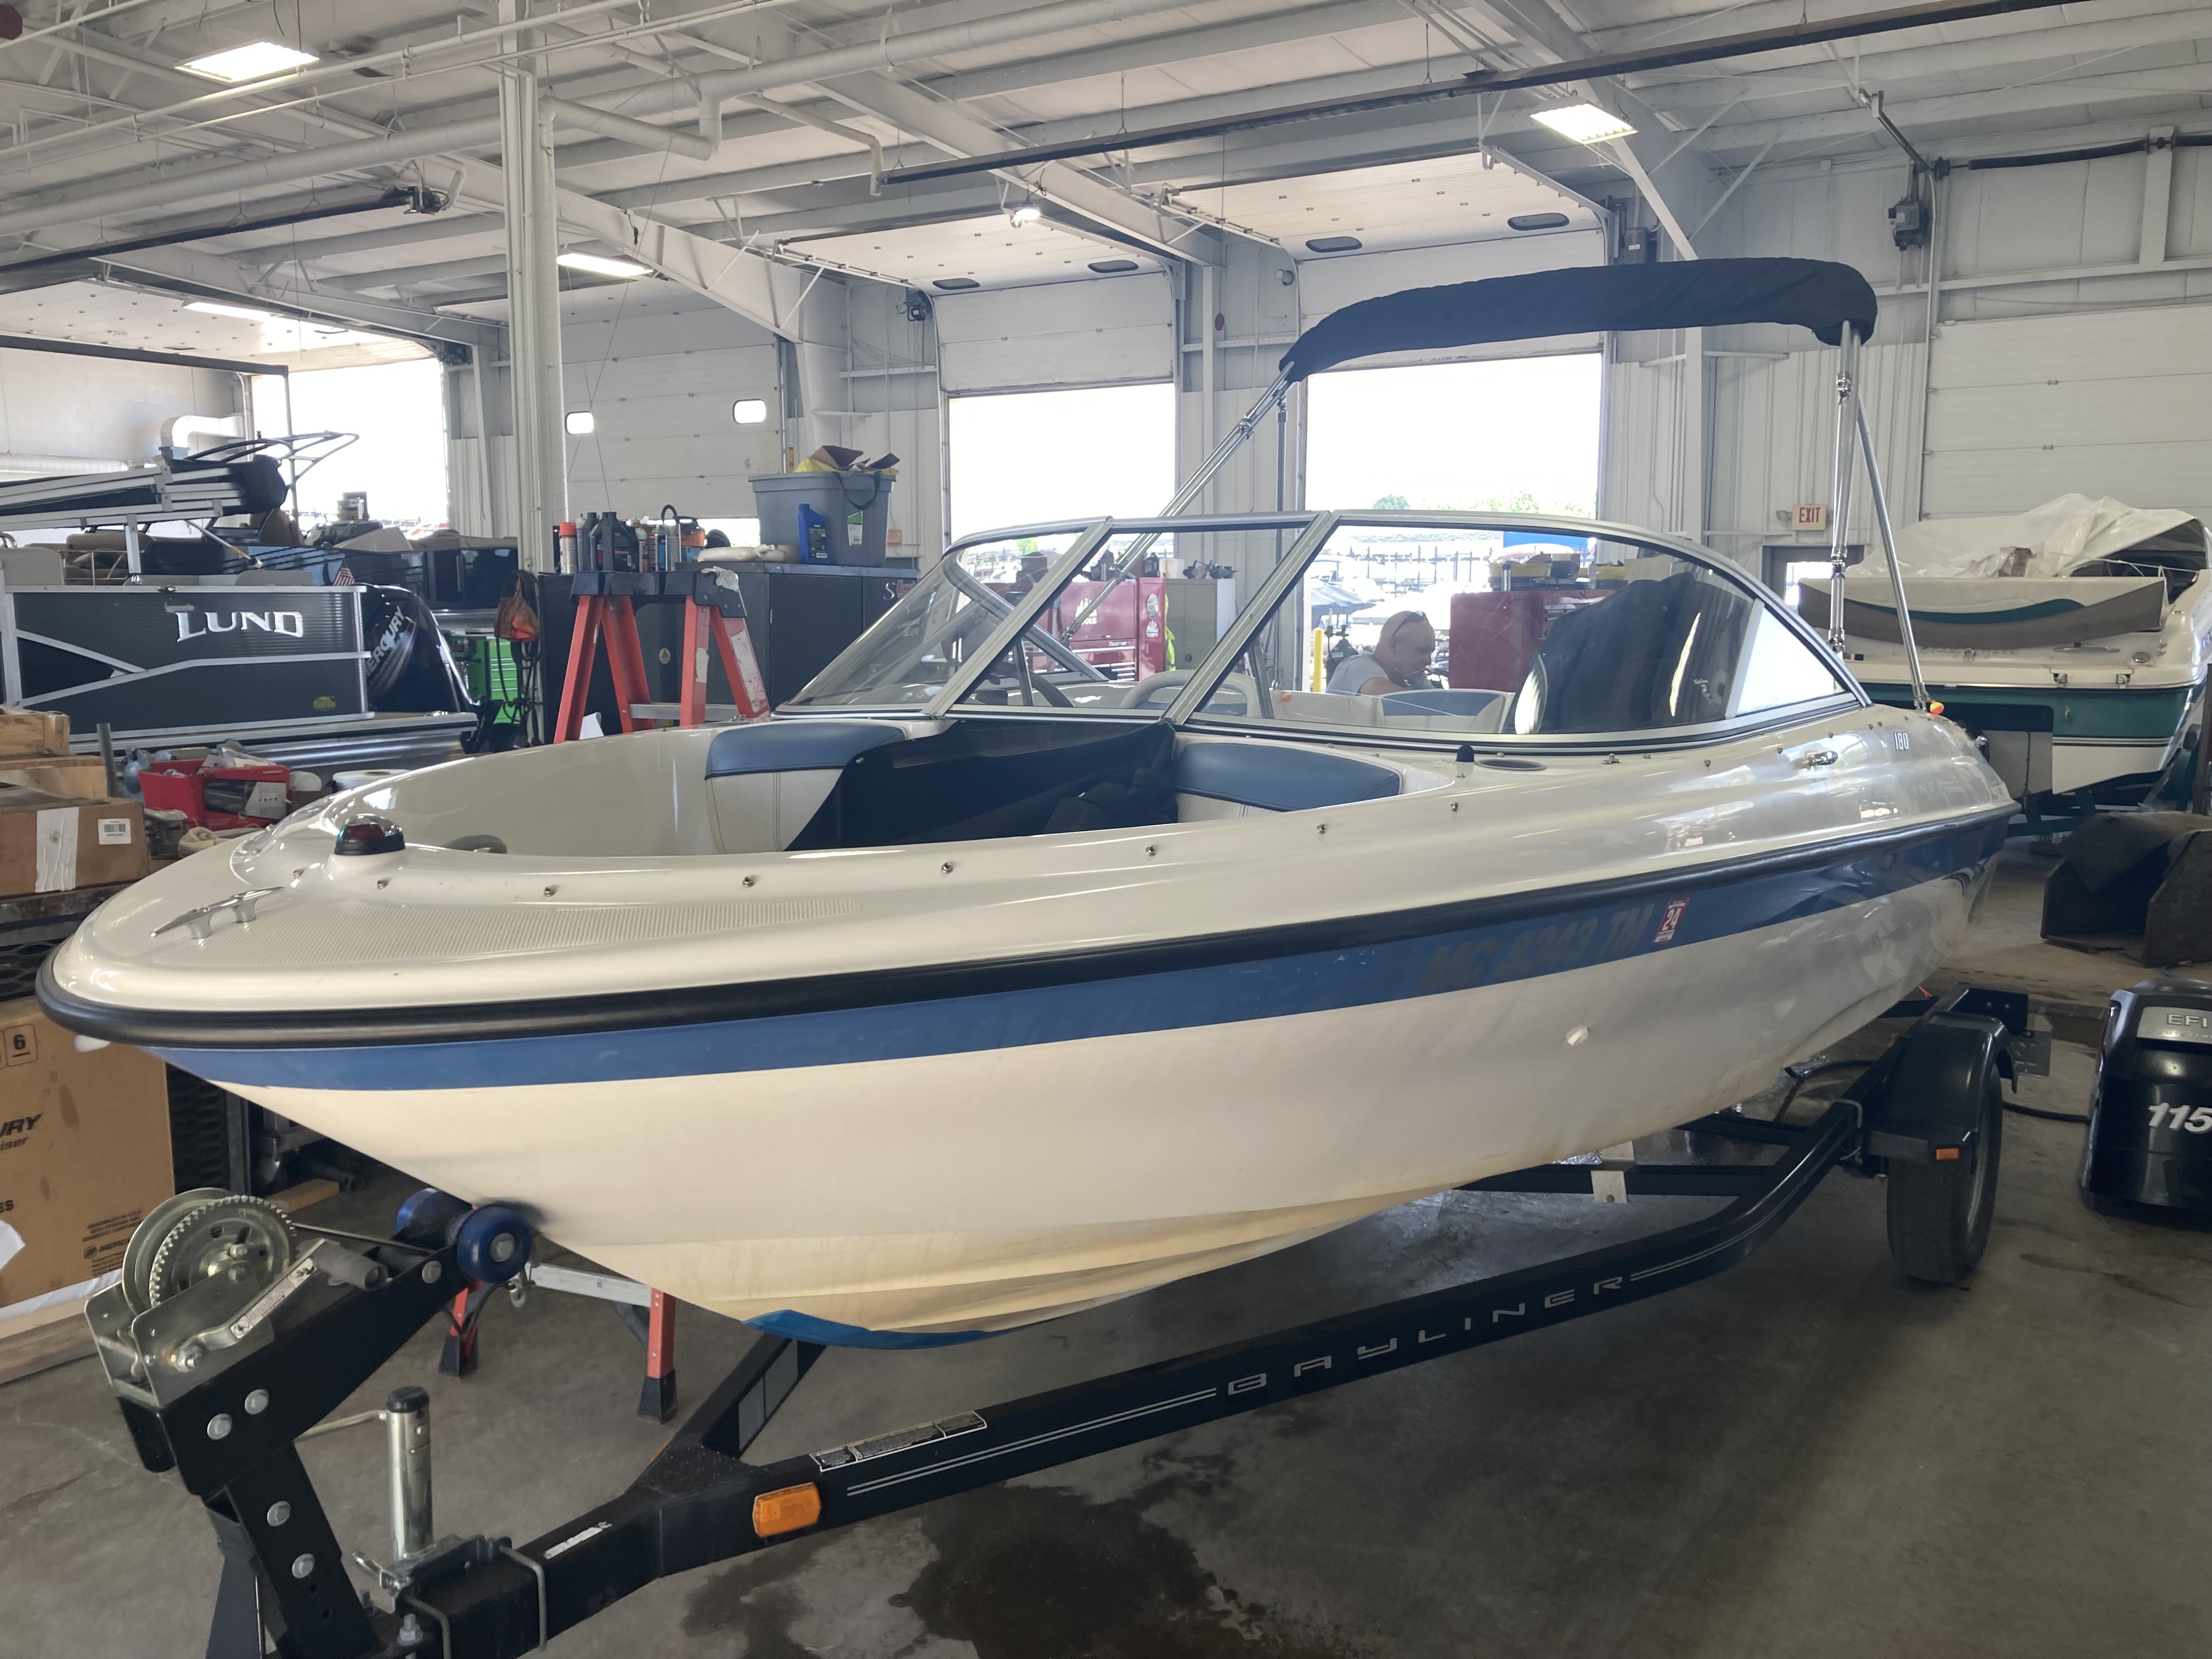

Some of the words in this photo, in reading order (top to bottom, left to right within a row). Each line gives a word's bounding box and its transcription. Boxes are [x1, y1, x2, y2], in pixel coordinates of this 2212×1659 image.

[1799, 507, 1821, 523] EXIT
[175, 611, 303, 642] LUND
[1893, 732, 1909, 751] 180
[1598, 904, 1655, 957] TM
[1661, 907, 1682, 931] 24
[2166, 1014, 2208, 1028] EFI
[14, 1034, 26, 1050] 6
[2148, 1102, 2212, 1135] 115
[1228, 1276, 1623, 1395] BAYLINER
